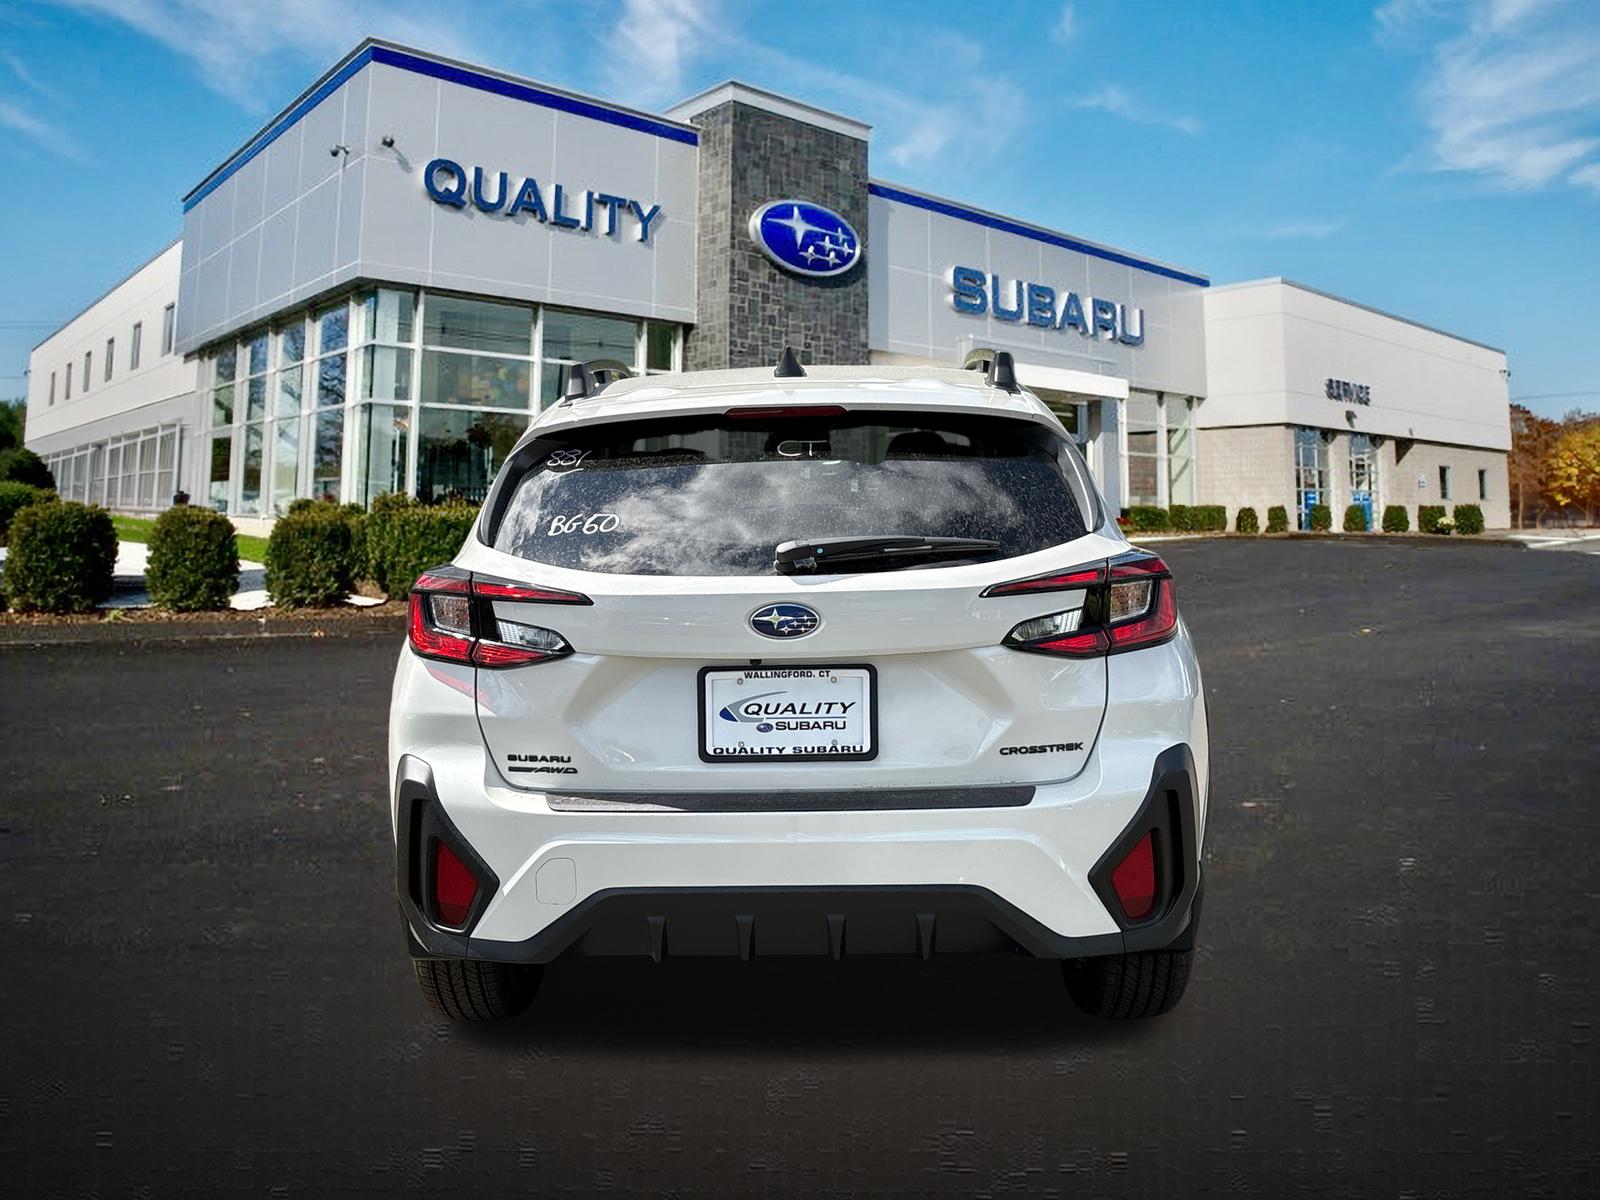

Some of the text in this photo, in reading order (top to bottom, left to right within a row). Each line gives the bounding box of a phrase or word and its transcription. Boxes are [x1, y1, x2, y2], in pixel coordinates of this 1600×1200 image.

[424, 159, 662, 243] QUALITY
[951, 265, 1145, 346] SUBARU
[777, 440, 828, 457] CT
[818, 670, 831, 678] CT
[743, 701, 856, 716] QUALITY
[775, 721, 846, 731] SUBARU
[713, 745, 864, 755] QUALITY SUBARU
[999, 742, 1084, 756] CROSSTREK
[507, 754, 571, 763] SUBARU
